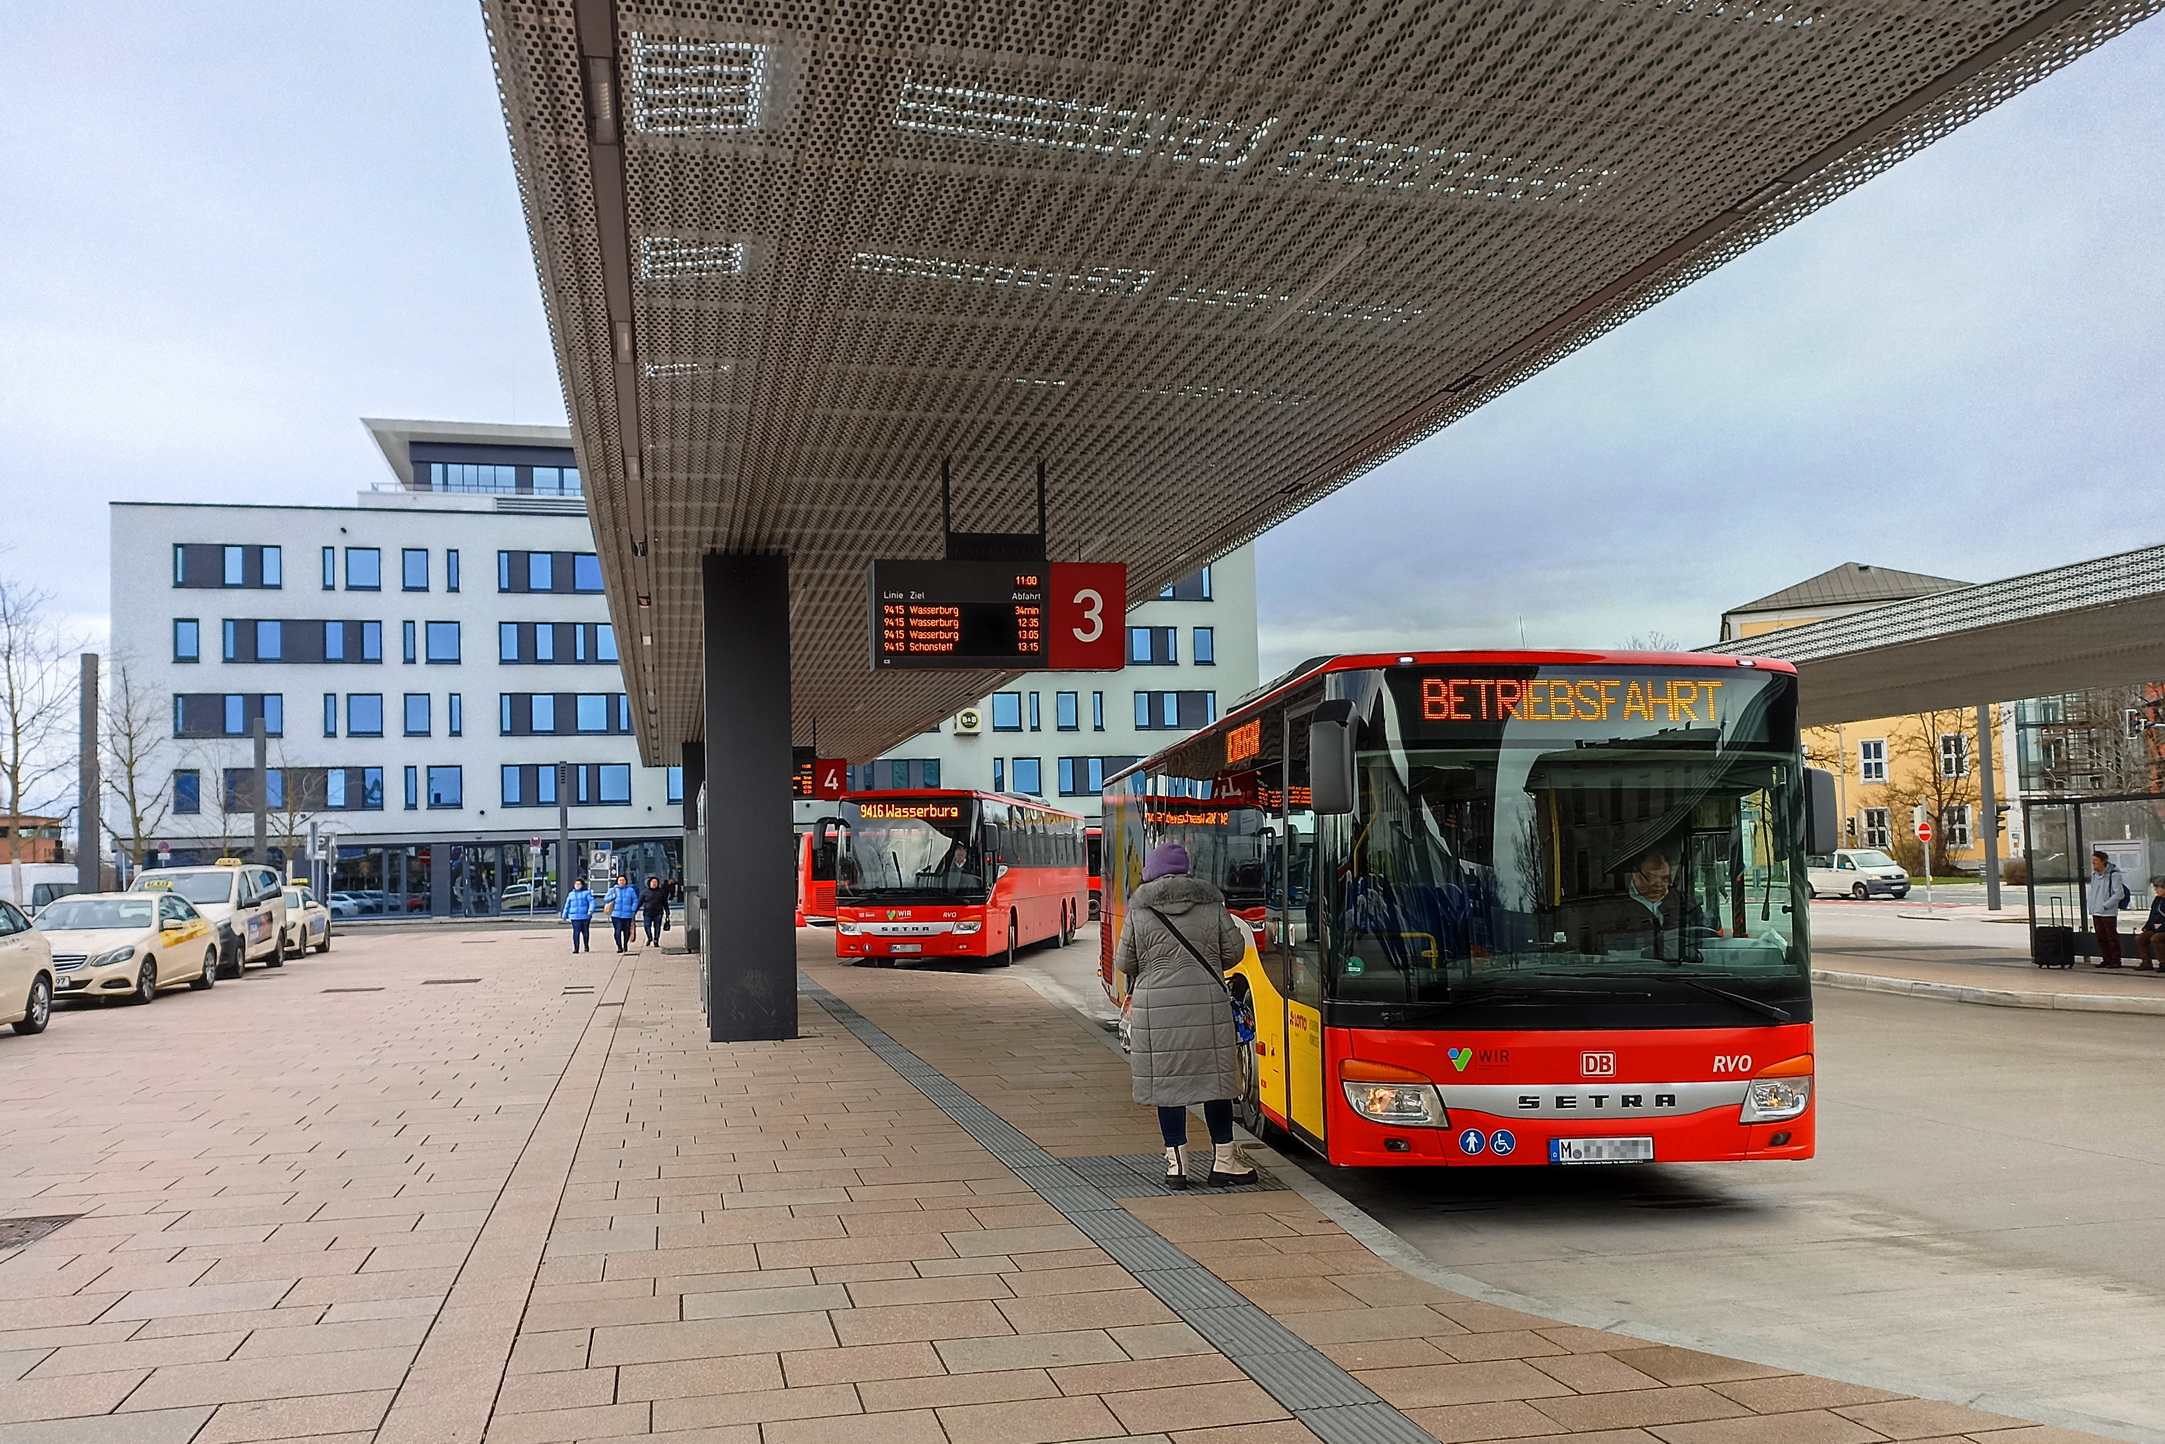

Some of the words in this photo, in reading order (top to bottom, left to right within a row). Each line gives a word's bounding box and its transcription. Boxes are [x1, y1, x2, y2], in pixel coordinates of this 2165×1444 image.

[1016, 576, 1037, 585] 11:00
[883, 591, 904, 599] Linie
[909, 591, 925, 600] Ziel
[1012, 592, 1041, 600] Abfahrt
[884, 605, 905, 615] 9415
[909, 605, 959, 617] Wasserburg
[1014, 606, 1039, 615] 34min
[1072, 588, 1104, 643] 3
[884, 617, 905, 627] 9415
[909, 618, 959, 630] Wasserburg
[1018, 618, 1039, 627] 12:35
[884, 629, 905, 639] 9415
[909, 630, 959, 642] Wasserburg
[1018, 630, 1039, 639] 13:05
[884, 642, 905, 652] 9415
[909, 642, 953, 652] Schonstett
[1018, 642, 1039, 652] 13:15
[1422, 678, 1723, 721] BETRIEBSFAHRT
[824, 768, 839, 790] 4
[860, 804, 884, 818] 9416
[885, 803, 958, 818] Wasserburg
[898, 910, 912, 918] WIR
[1478, 1049, 1510, 1063] WIR
[1585, 1055, 1612, 1073] DB
[1712, 1054, 1753, 1073] RVO
[1518, 1094, 1677, 1110] SETRA
